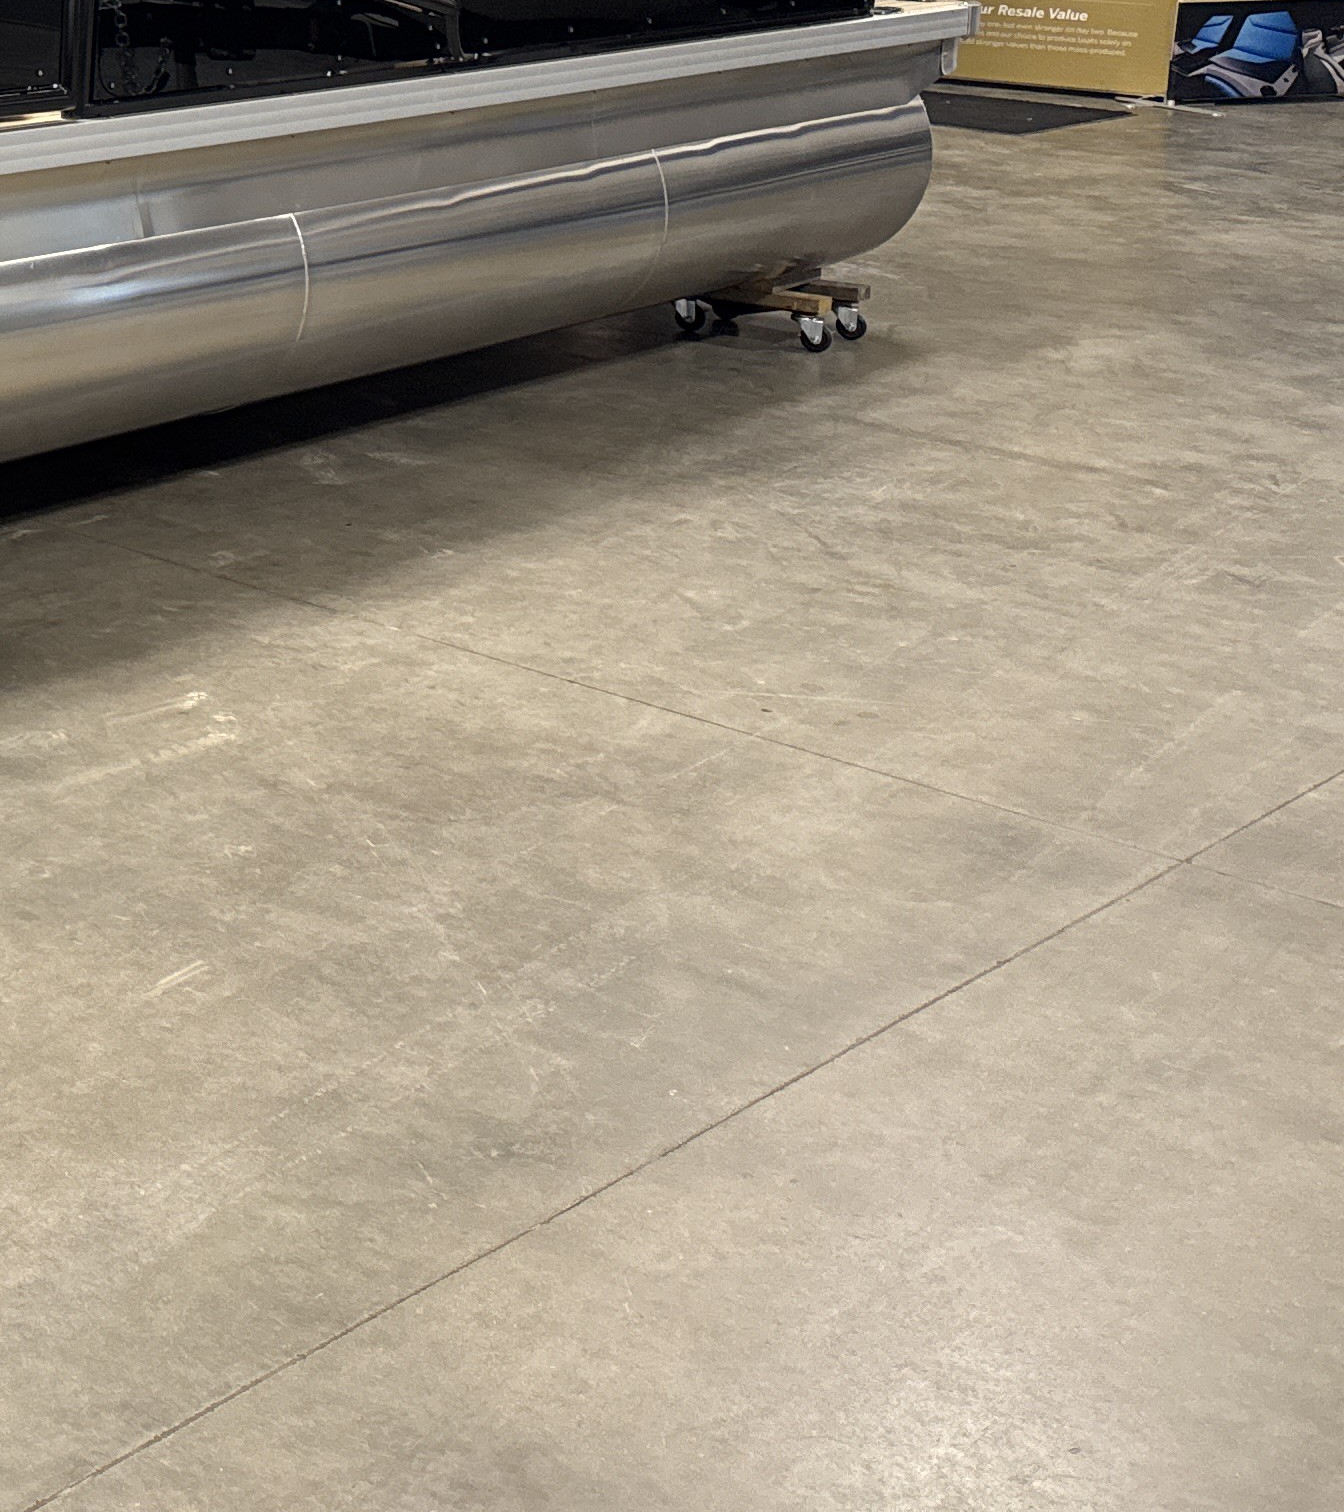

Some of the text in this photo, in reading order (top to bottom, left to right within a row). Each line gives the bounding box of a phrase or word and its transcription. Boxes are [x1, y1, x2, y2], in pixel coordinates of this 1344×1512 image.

[980, 4, 1089, 22] ur Resale Value
